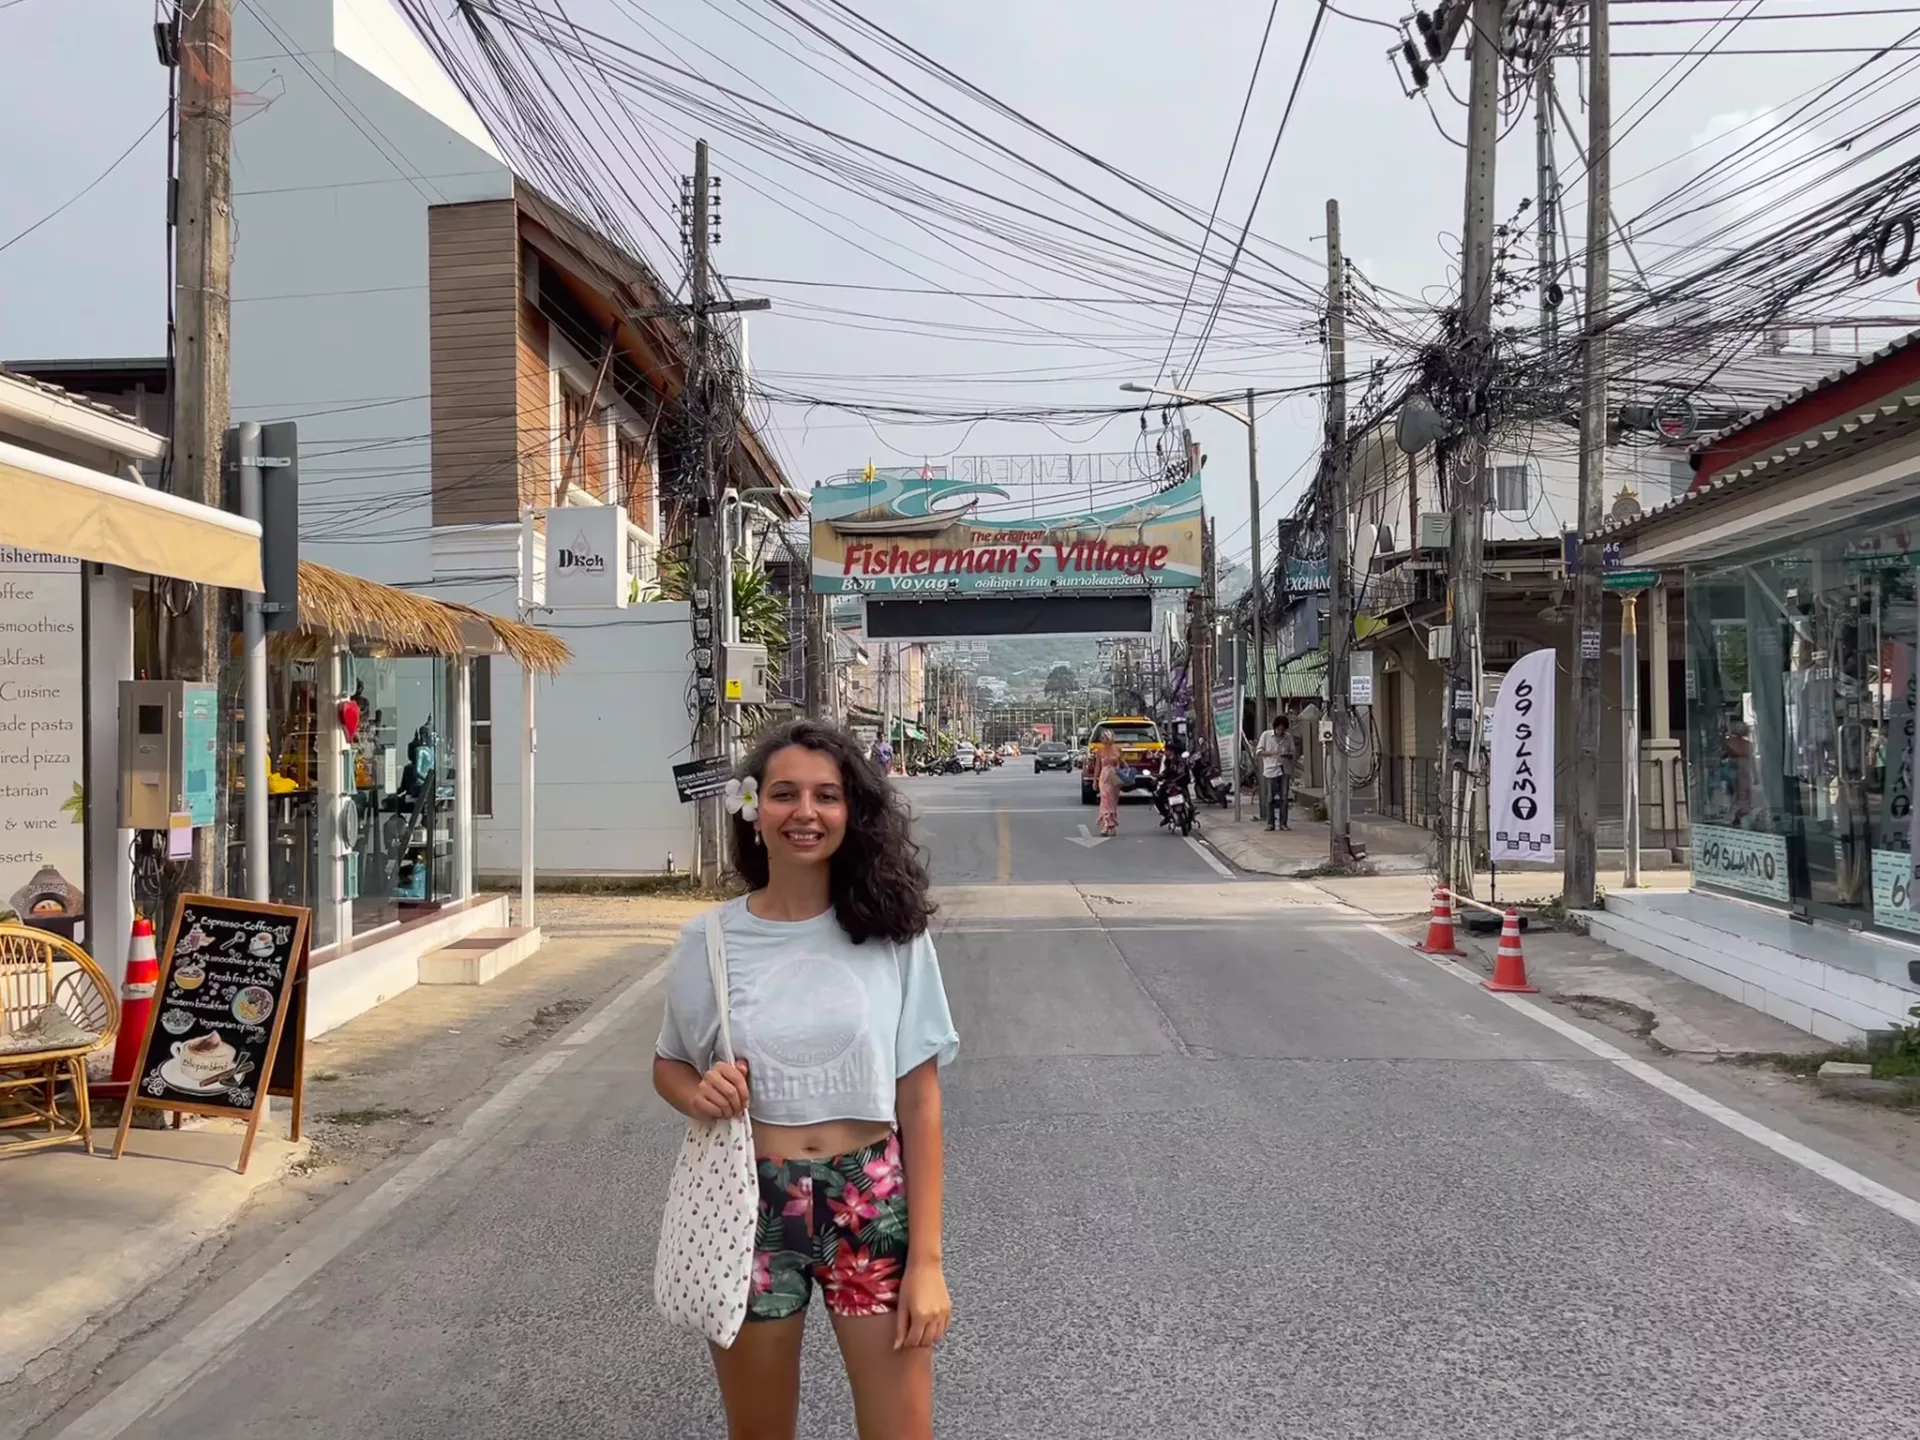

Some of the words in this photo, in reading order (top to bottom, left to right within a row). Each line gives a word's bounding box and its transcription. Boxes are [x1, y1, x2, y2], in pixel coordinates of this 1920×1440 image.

[971, 531, 991, 543] The
[842, 542, 1042, 576] Fisherman's
[1054, 539, 1169, 576] Village
[841, 577, 876, 591] Bon
[890, 577, 960, 592] Voyage
[0, 680, 61, 701] Cuisine
[31, 718, 74, 739] pasta
[33, 749, 71, 771] pizza
[23, 816, 58, 829] wine
